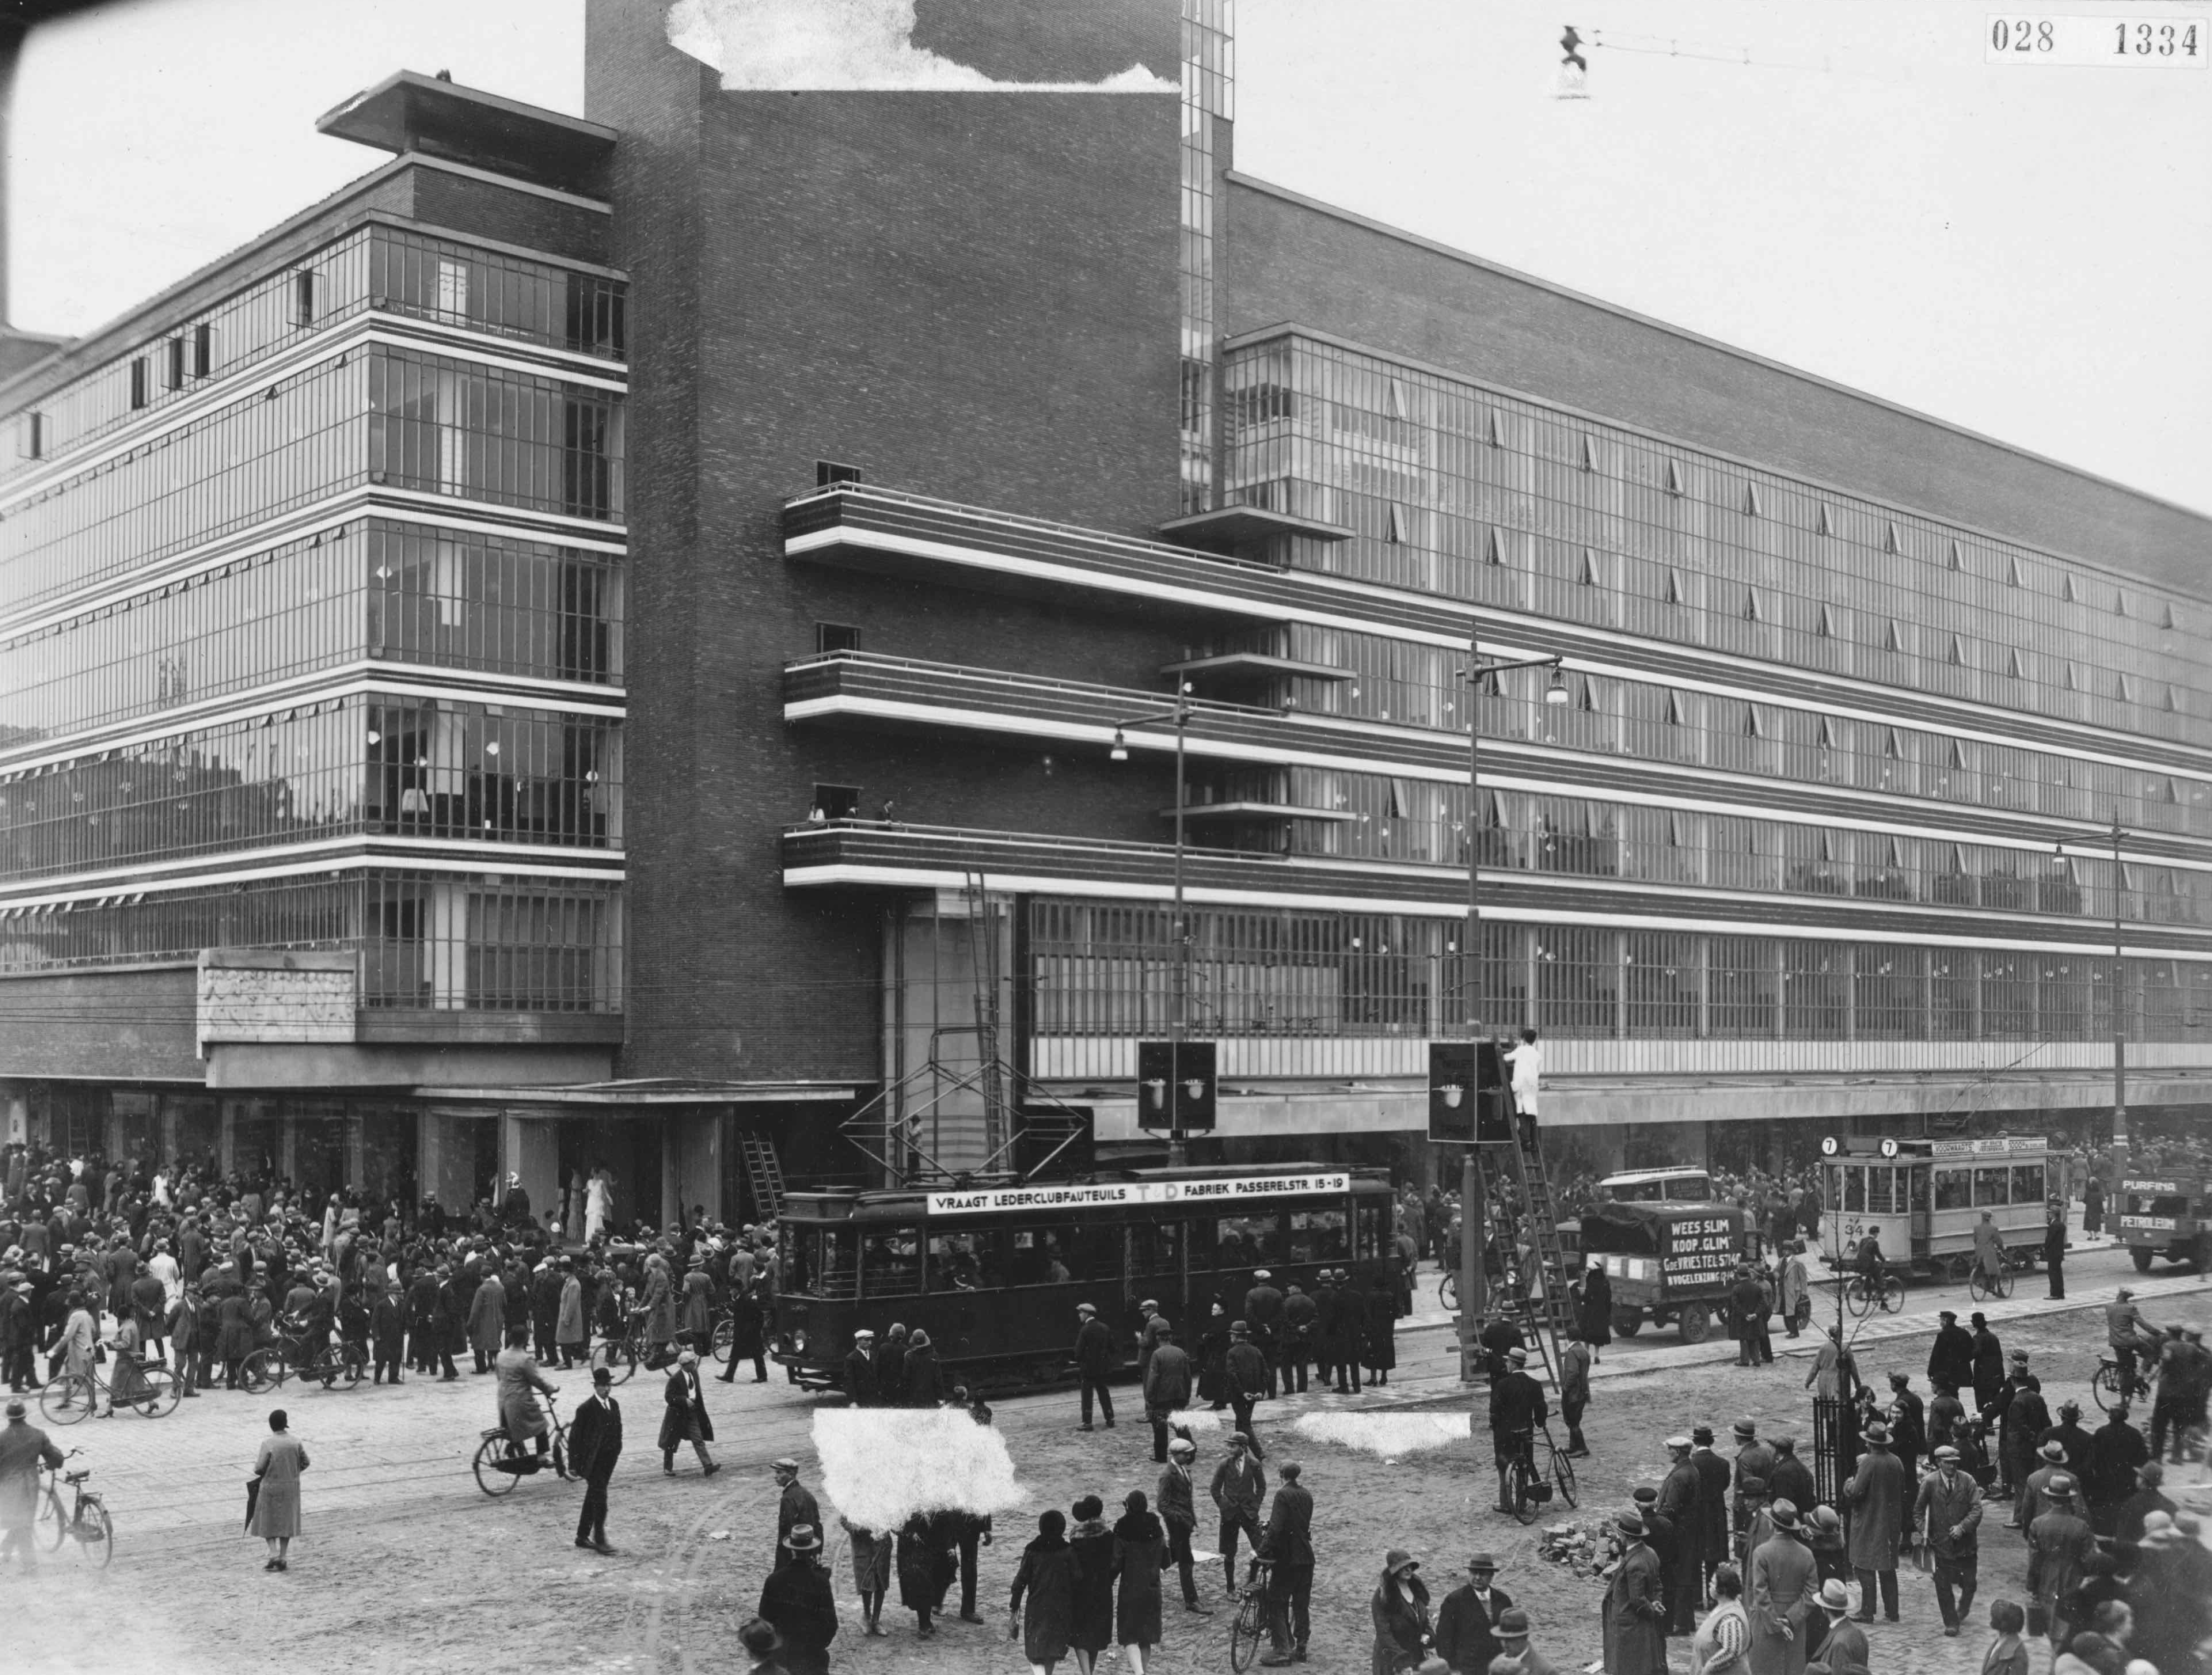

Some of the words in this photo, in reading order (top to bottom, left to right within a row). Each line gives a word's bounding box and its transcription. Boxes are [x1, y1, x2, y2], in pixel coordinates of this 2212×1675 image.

[1825, 1140, 1833, 1152] 7
[1885, 1141, 1893, 1154] 7
[2123, 1180, 2176, 1191] PURFINA
[936, 1195, 988, 1209] VRAAGT
[994, 1188, 1126, 1206] LEDERCLUBFAUTEUILS
[1135, 1184, 1150, 1202] T
[1165, 1183, 1179, 1201] D
[1184, 1183, 1230, 1197] FABRIEK
[1236, 1179, 1310, 1193] PASSERELSTR.
[1671, 1221, 1701, 1235] WEES
[1704, 1219, 1729, 1233] SLIM
[1845, 1224, 1864, 1236] 34
[1672, 1239, 1698, 1252] KOOP
